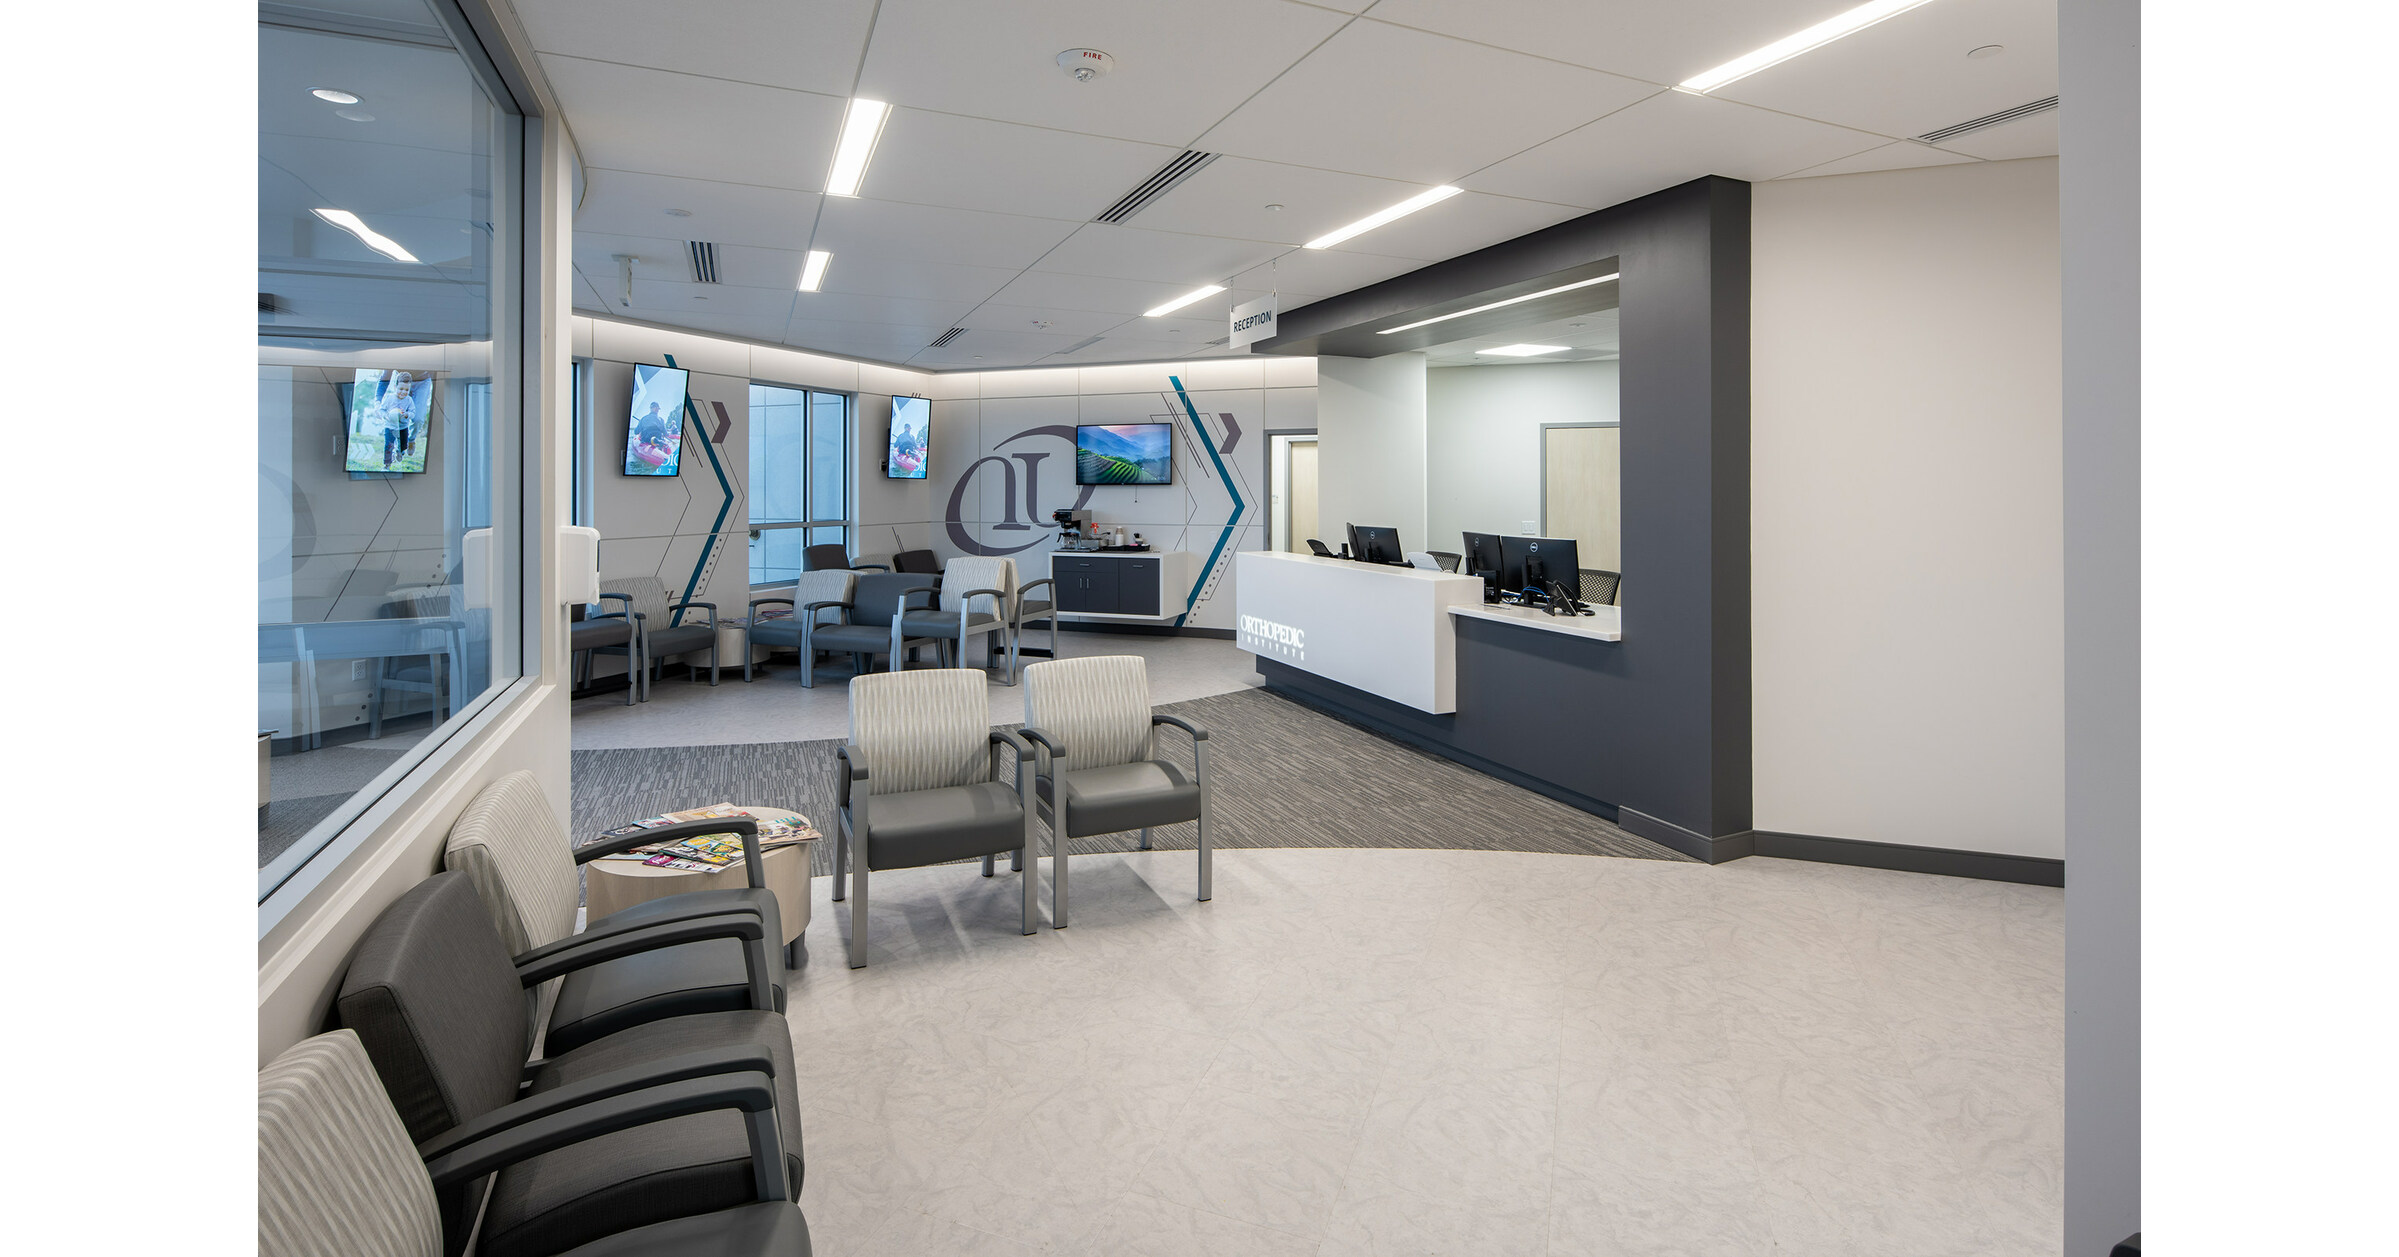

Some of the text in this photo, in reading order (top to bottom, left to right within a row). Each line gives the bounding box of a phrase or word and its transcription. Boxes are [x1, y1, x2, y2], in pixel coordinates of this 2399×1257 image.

[1083, 51, 1103, 61] FIRE
[1233, 310, 1272, 333] RECEPTION
[1240, 614, 1305, 649] ORTHOPEDIC
